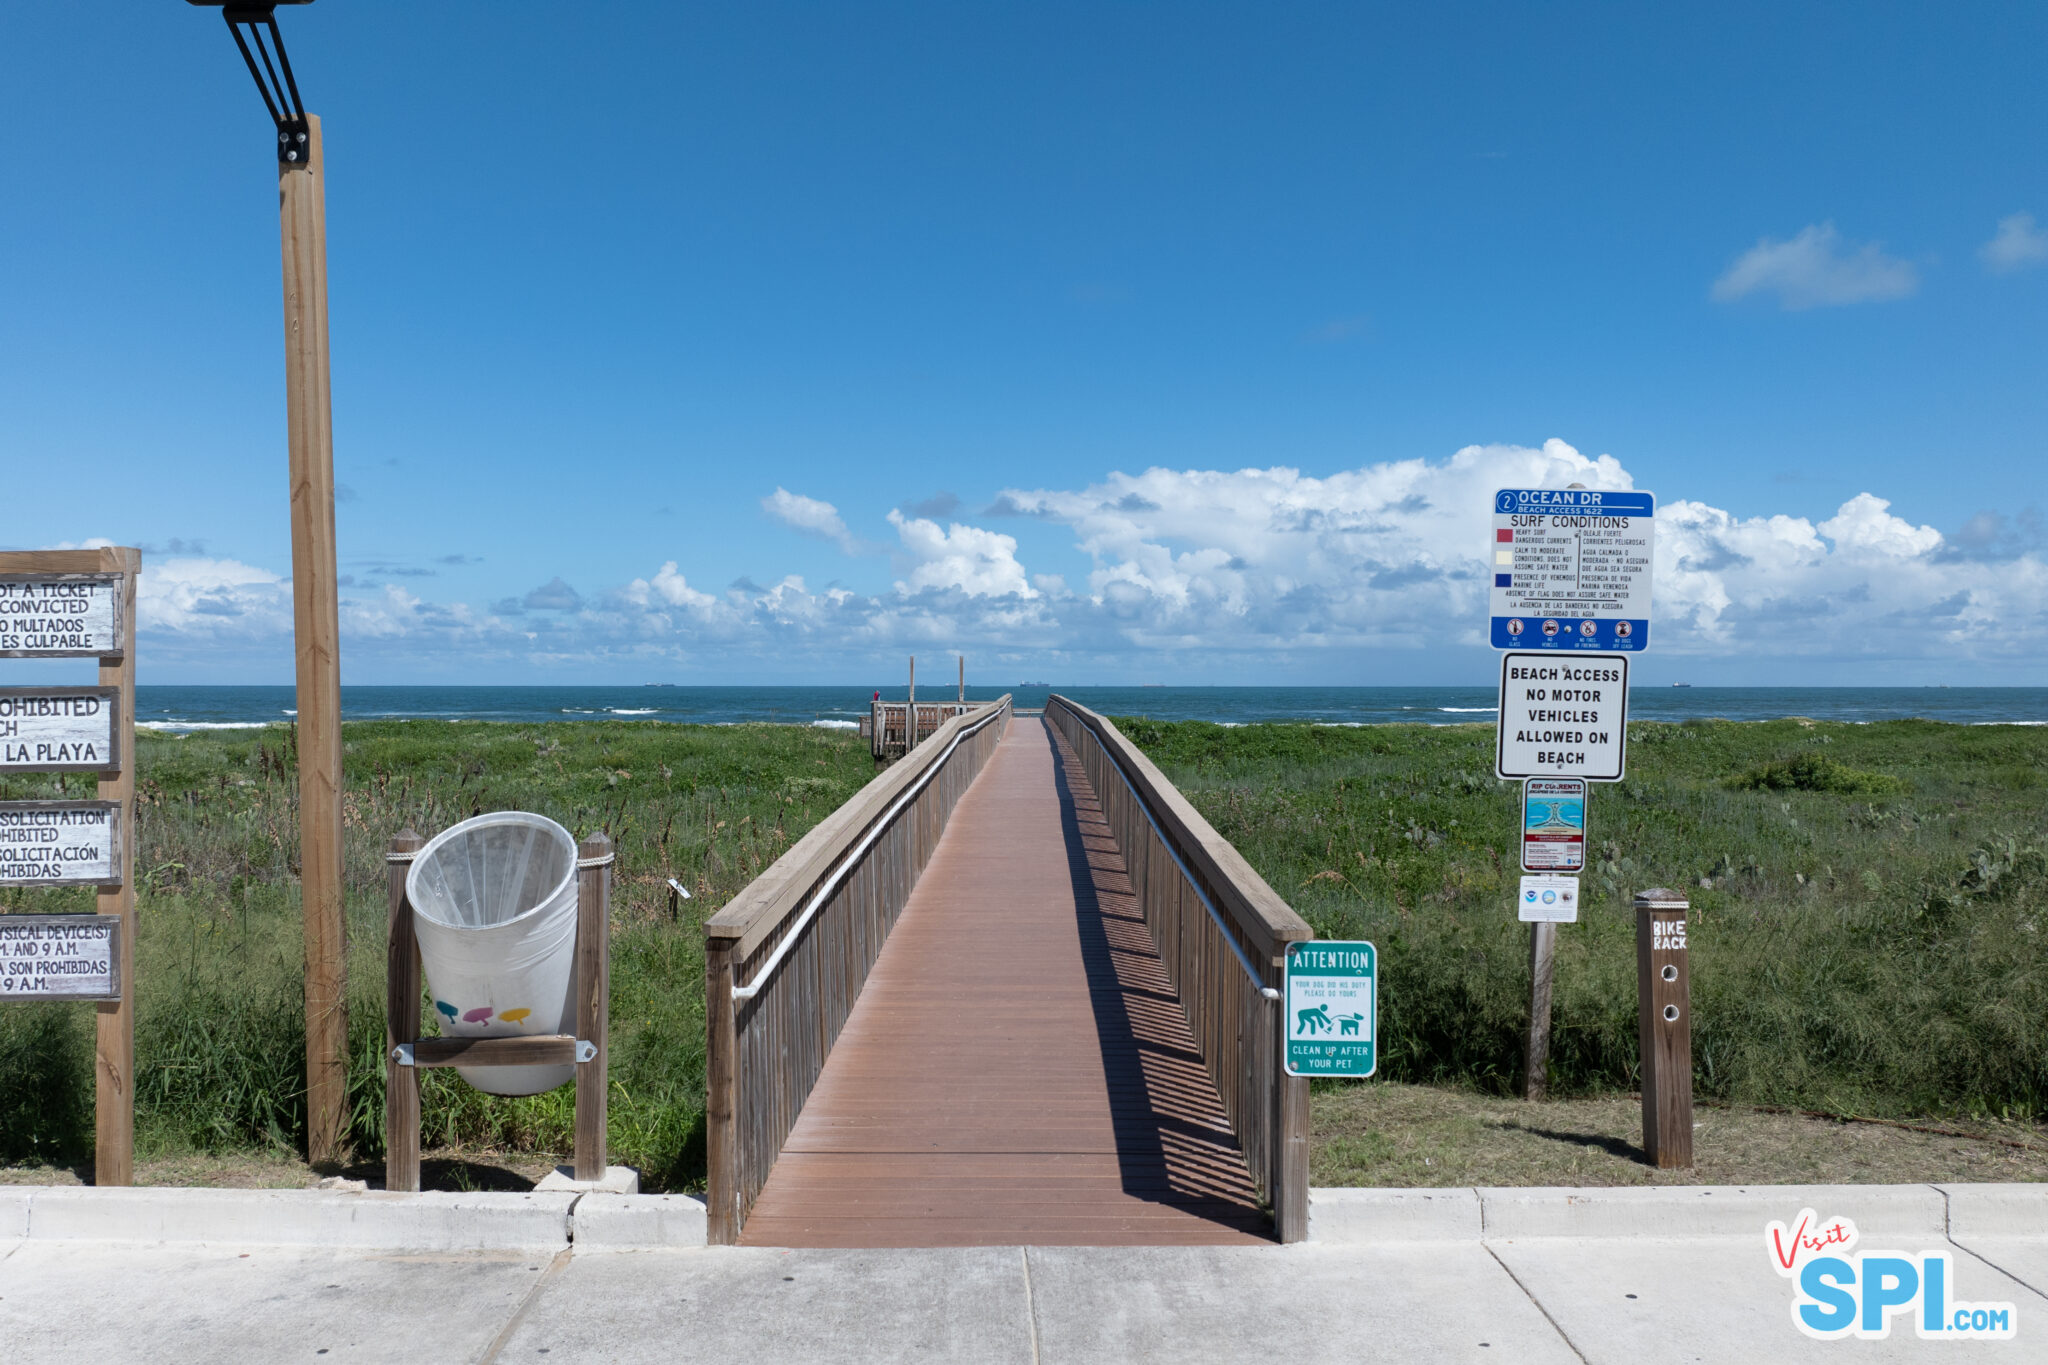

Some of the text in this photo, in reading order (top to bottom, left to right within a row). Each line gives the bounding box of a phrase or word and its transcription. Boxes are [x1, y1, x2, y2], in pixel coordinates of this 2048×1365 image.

[1504, 496, 1510, 508] 2
[1518, 491, 1602, 505] OCEAN DR
[1511, 515, 1629, 528] SURF CONDITIONS
[23, 584, 35, 598] A
[41, 583, 97, 598] TICKET
[0, 600, 89, 614] CONVICTED
[14, 618, 84, 632] MULTADOS
[2, 634, 93, 648] ES CULPABLE
[1511, 668, 1619, 682] BEACH ACCESS
[1526, 688, 1601, 702] NO MOTOR
[0, 696, 100, 717] OHIBITED
[1528, 710, 1598, 723] VEHICLES
[1516, 730, 1608, 744] ALLOWED ON
[6, 743, 97, 762] LA PLAYA
[1538, 752, 1584, 764] BEACH
[0, 810, 105, 826] SOLICITATION
[0, 828, 58, 842] HIBITED
[0, 864, 62, 878] HIBIDAS
[47, 925, 108, 940] DEVICE(S)
[1653, 920, 1686, 936] BIKE
[14, 942, 38, 956] AND
[42, 942, 51, 956] 9
[55, 942, 79, 956] A.M.
[1654, 936, 1686, 950] RACK
[1294, 952, 1368, 968] ATTENTION
[9, 962, 33, 975] SON
[36, 960, 107, 974] PROHIBIDAS
[4, 977, 48, 991] 9 A.M.
[1292, 1046, 1368, 1056] CLEAN UP AFTER
[1309, 1060, 1352, 1068] YOUR PET
